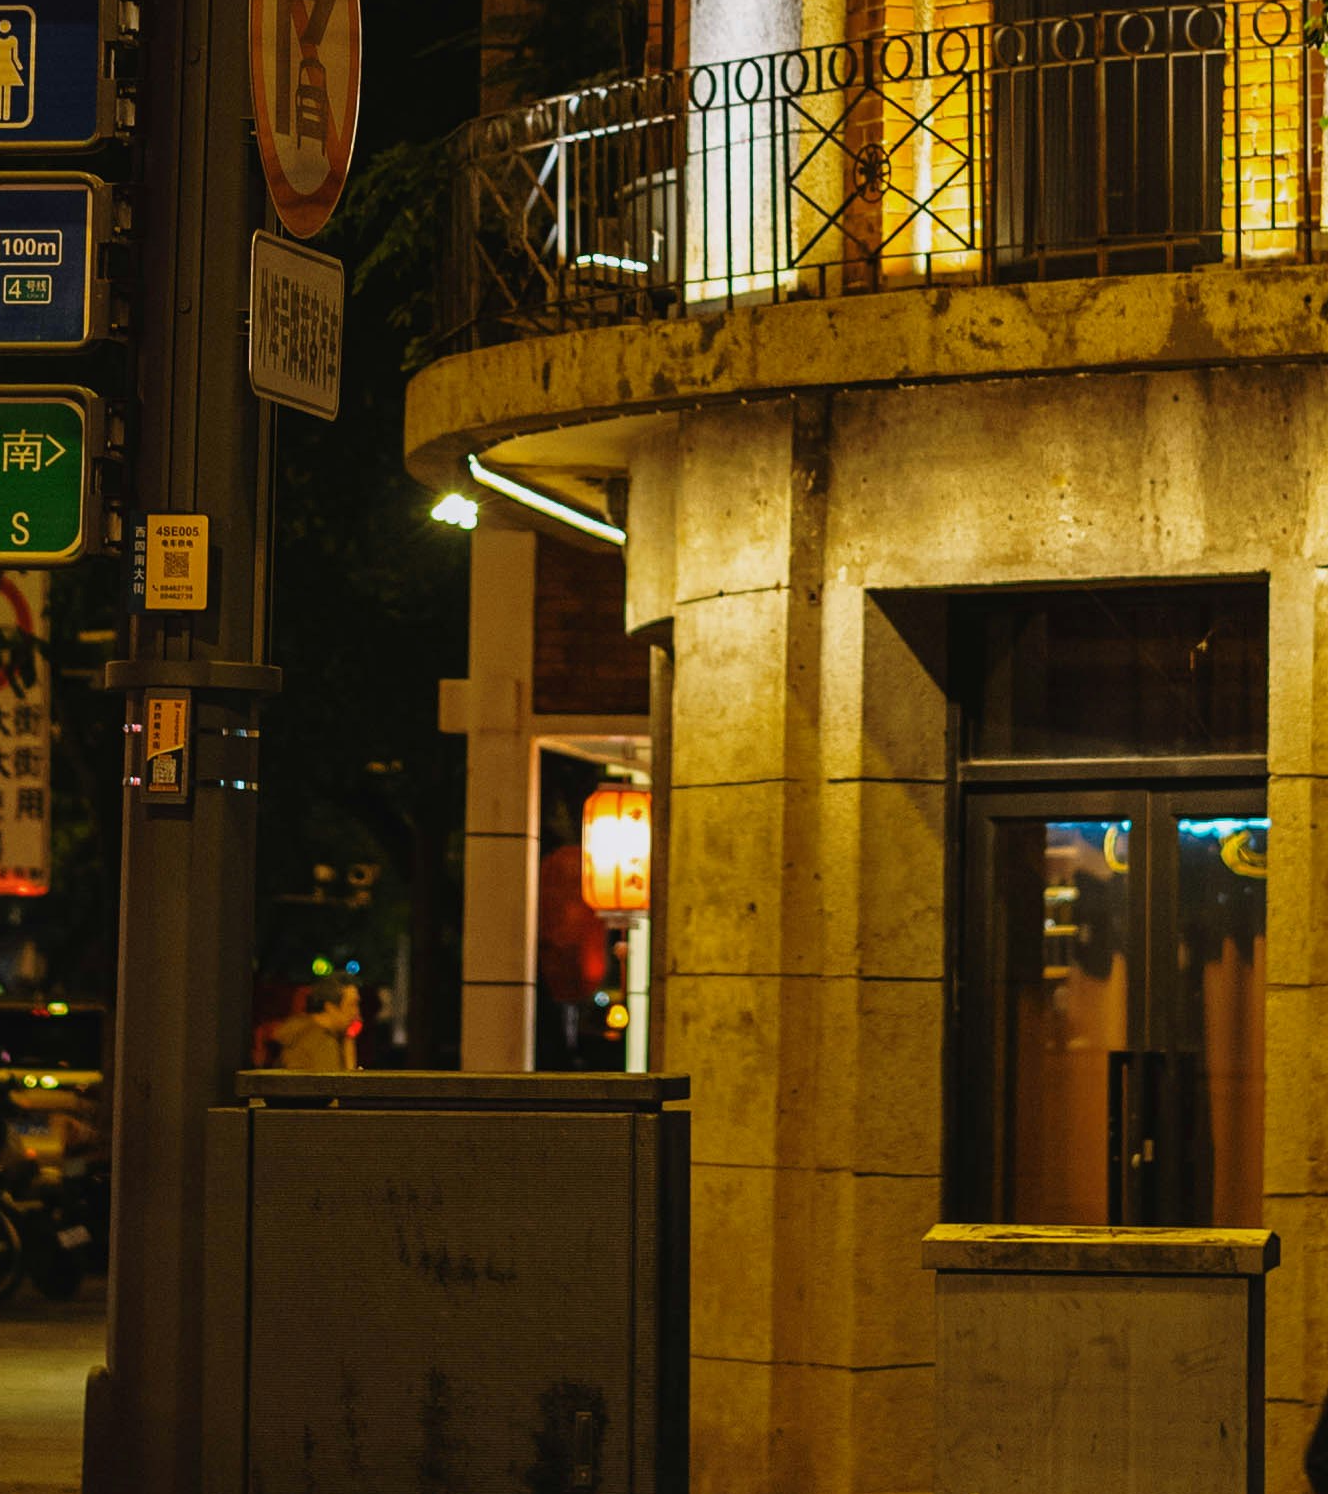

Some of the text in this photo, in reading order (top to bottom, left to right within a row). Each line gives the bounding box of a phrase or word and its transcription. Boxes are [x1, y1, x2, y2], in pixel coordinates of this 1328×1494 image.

[1, 238, 57, 256] 100m
[1, 429, 43, 473] 南
[10, 511, 30, 545] S
[155, 525, 200, 537] 4SE005
